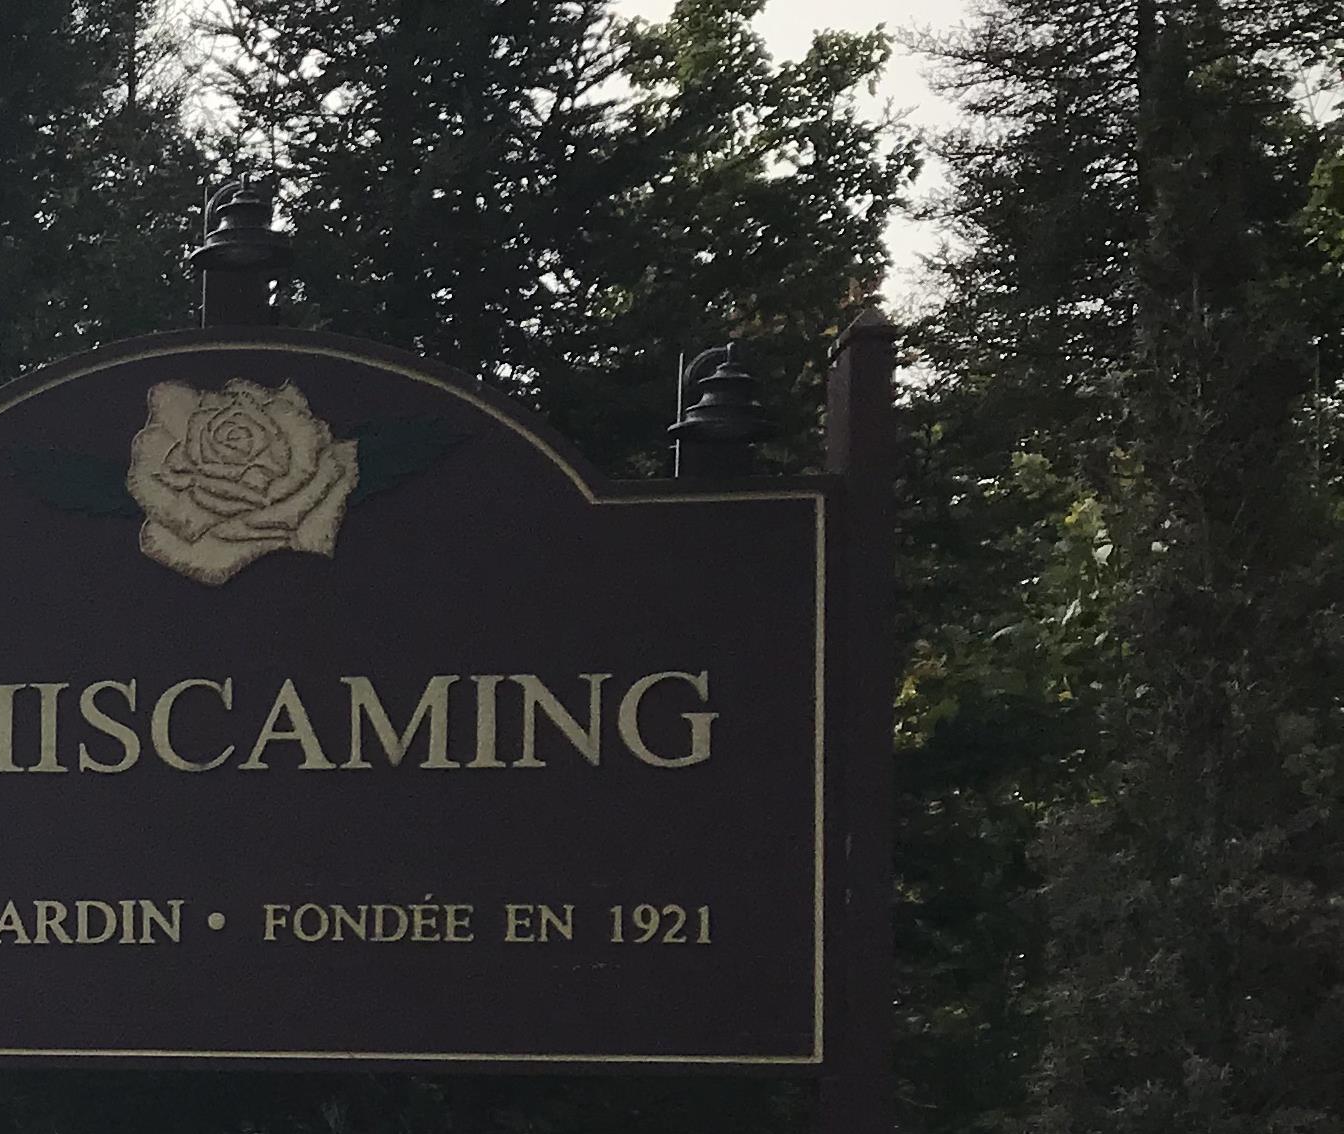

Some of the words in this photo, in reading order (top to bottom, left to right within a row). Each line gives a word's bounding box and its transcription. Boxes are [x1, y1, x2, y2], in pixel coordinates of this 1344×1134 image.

[263, 893, 474, 942] FONDÉE
[504, 904, 574, 942] EN
[611, 904, 712, 943] 1921
